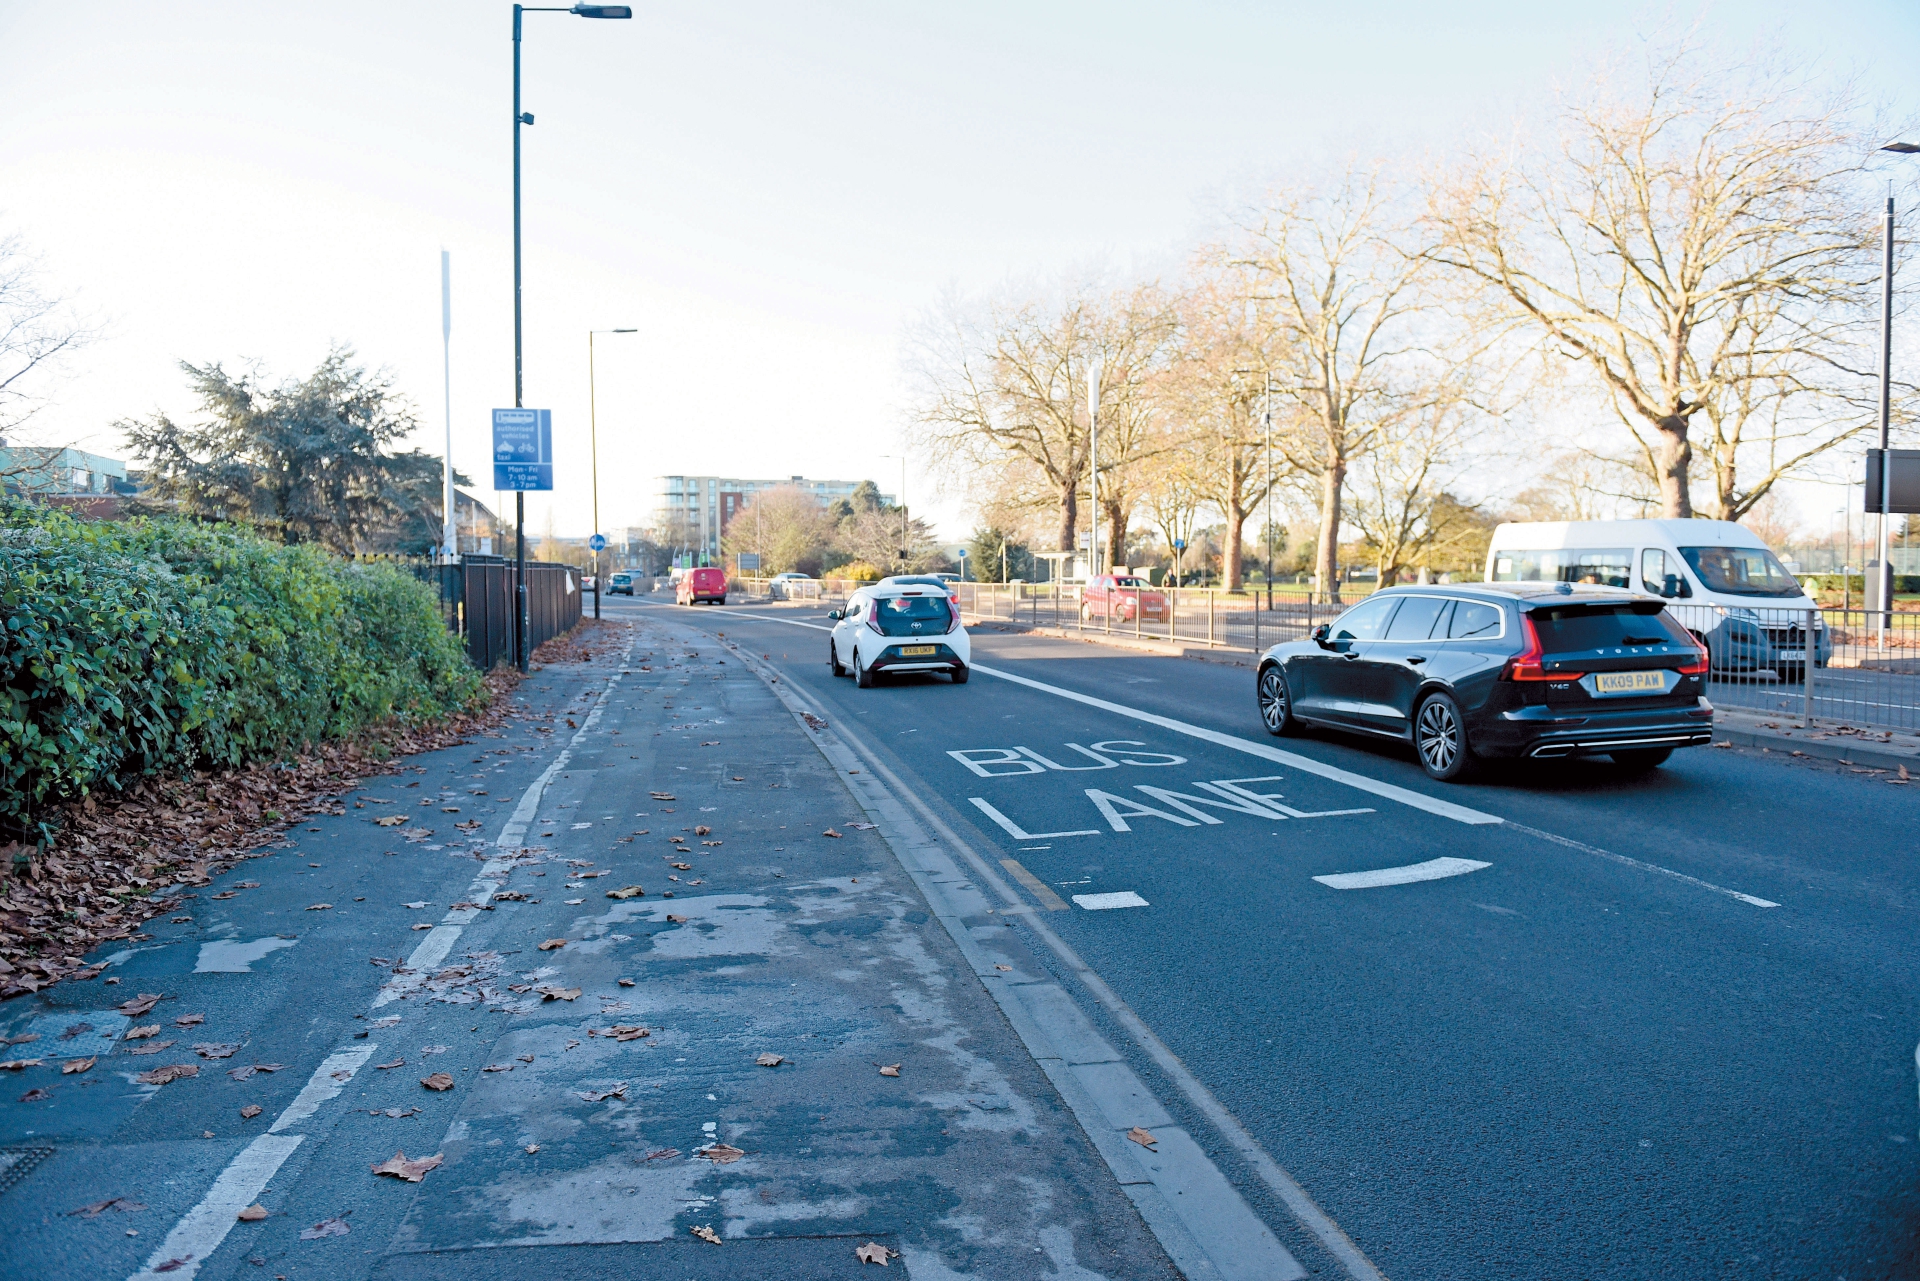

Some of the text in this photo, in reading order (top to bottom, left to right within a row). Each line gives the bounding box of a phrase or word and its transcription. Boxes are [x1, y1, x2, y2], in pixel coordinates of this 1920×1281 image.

[507, 465, 524, 473] Mon
[528, 465, 538, 473] Fri
[1596, 646, 1669, 655] VOLVO
[1602, 674, 1659, 689] KK09 PAW
[945, 740, 1187, 777] BUS
[968, 776, 1377, 840] LANE
